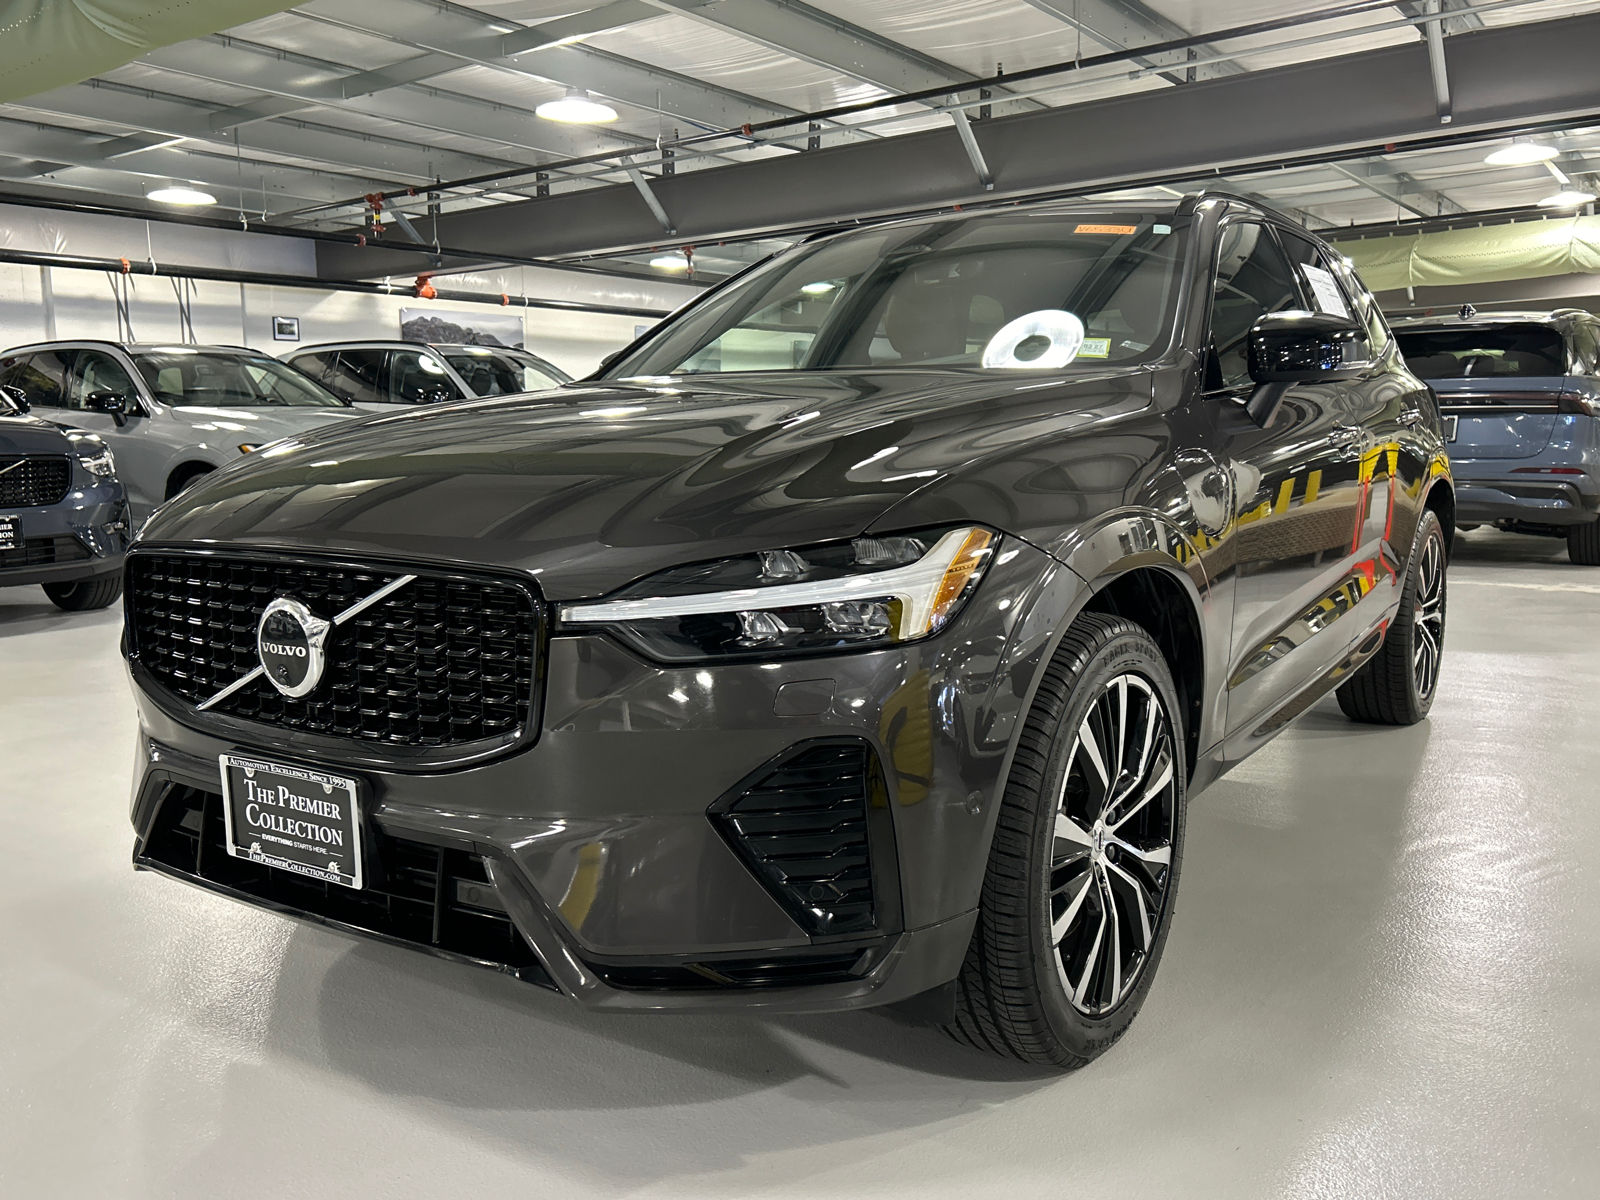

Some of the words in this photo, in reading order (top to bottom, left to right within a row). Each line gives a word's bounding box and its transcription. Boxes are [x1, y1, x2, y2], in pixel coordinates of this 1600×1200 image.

[261, 642, 306, 657] VOLVO
[230, 758, 270, 772] AUTOMOTIVE
[270, 765, 309, 779] EXCELLENCE
[309, 772, 328, 784] SINCE
[329, 777, 346, 788] 1995
[244, 779, 276, 806] THE
[277, 785, 342, 820] PREMIER
[245, 803, 343, 846] COLLECTION
[261, 833, 293, 847] EVERYTHING
[293, 841, 312, 851] STARTS
